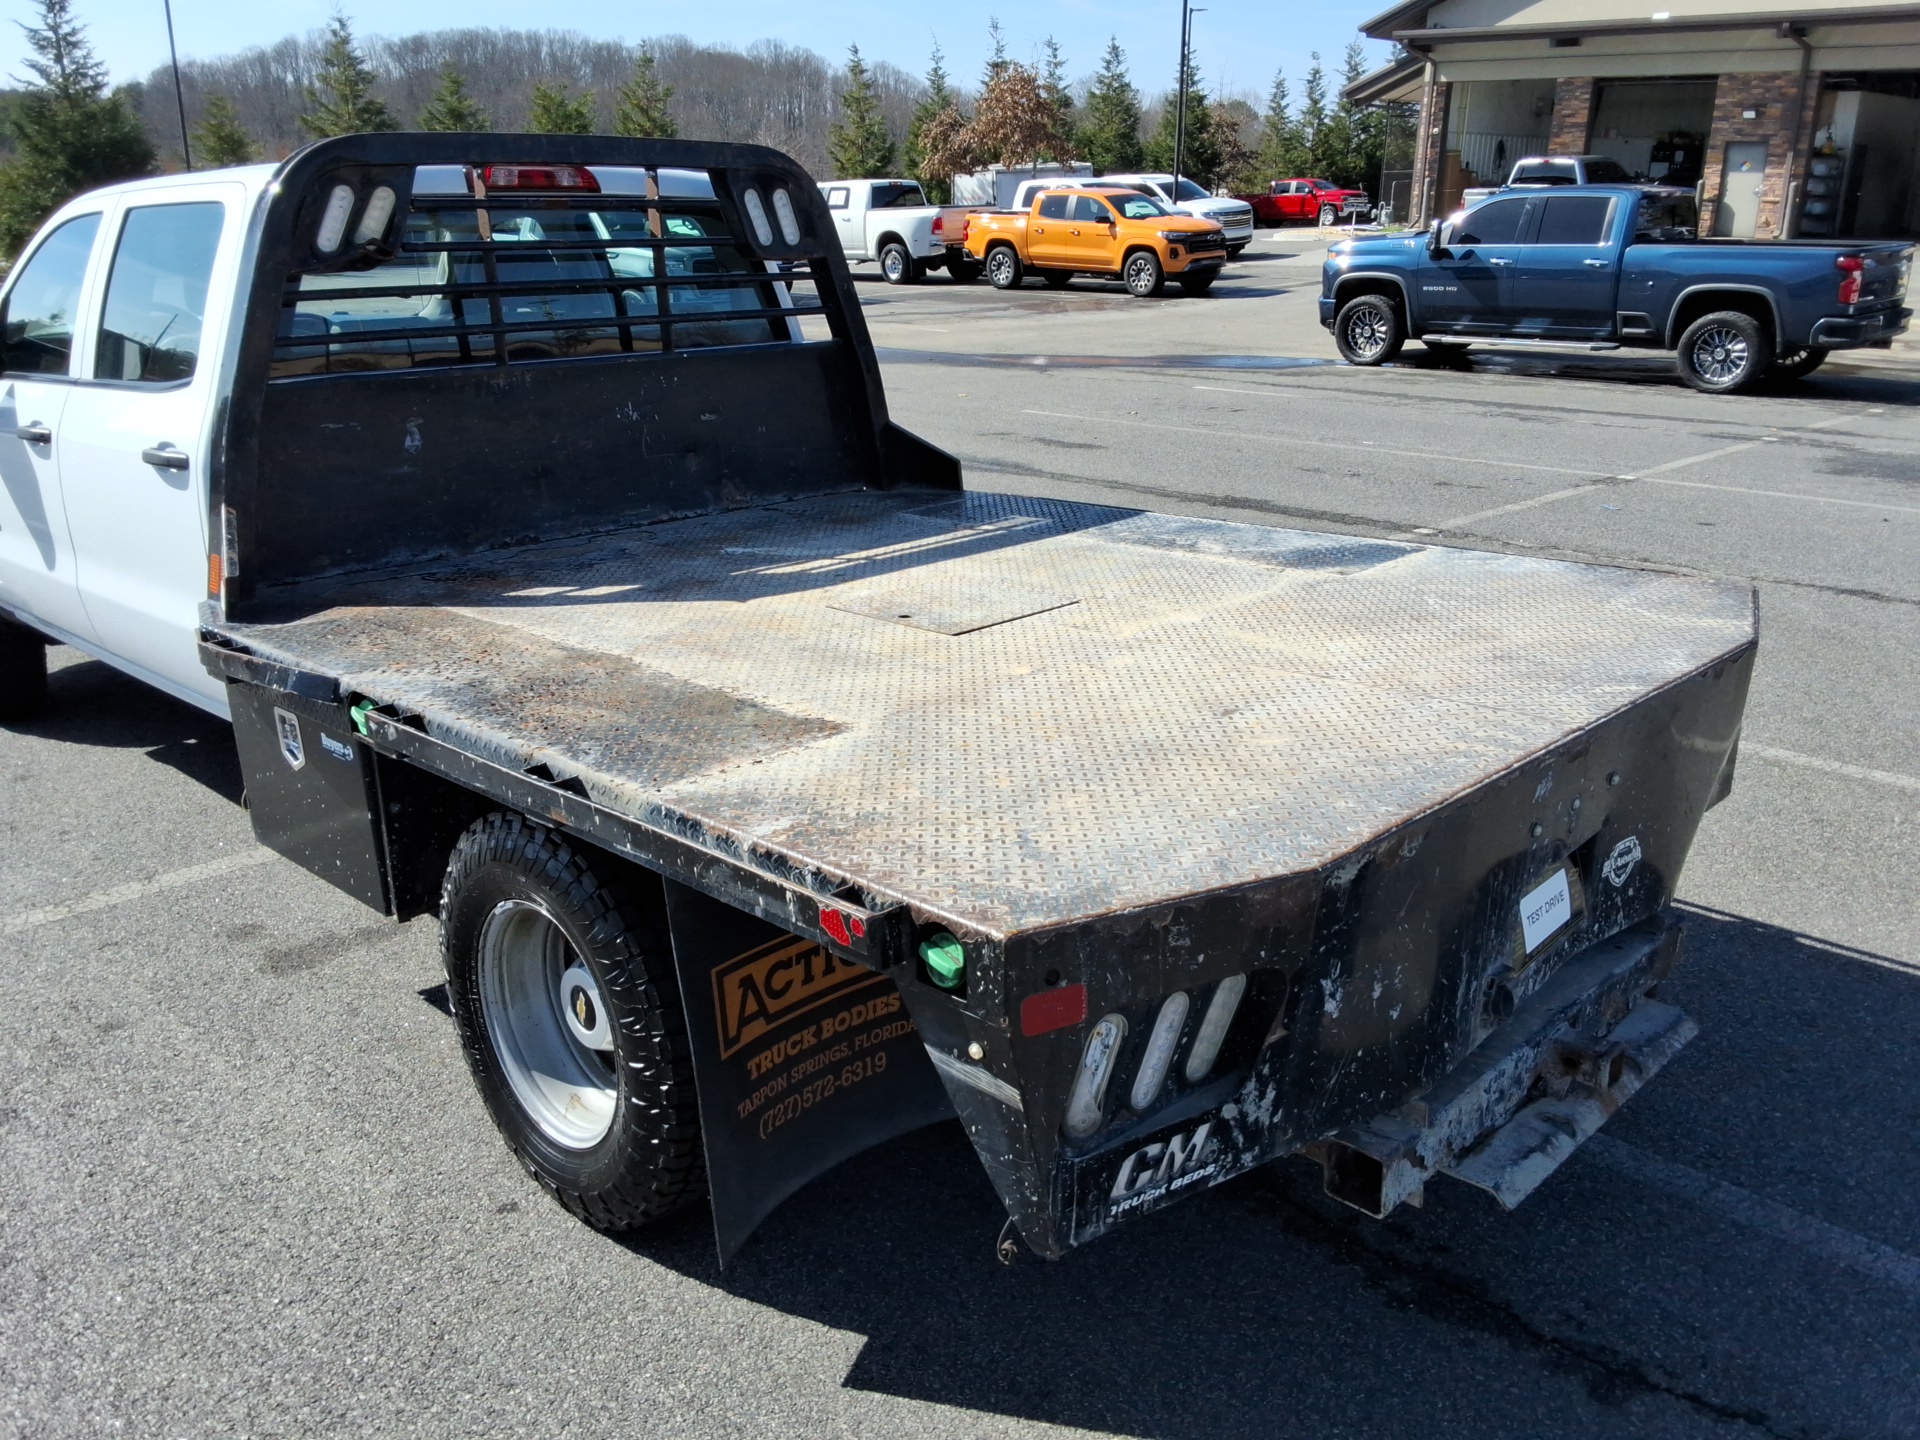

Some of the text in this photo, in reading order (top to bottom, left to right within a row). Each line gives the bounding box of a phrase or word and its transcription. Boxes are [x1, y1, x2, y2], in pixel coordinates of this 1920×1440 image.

[1526, 889, 1565, 927] TEST DRIVE
[724, 945, 858, 1050] ACTI
[747, 992, 901, 1081] TRUCK BODIES
[737, 1072, 789, 1120] TARPON
[854, 1018, 919, 1052] FLORIDA
[1110, 1122, 1213, 1200] CM
[1110, 1163, 1216, 1216] TRUCK BEDS
